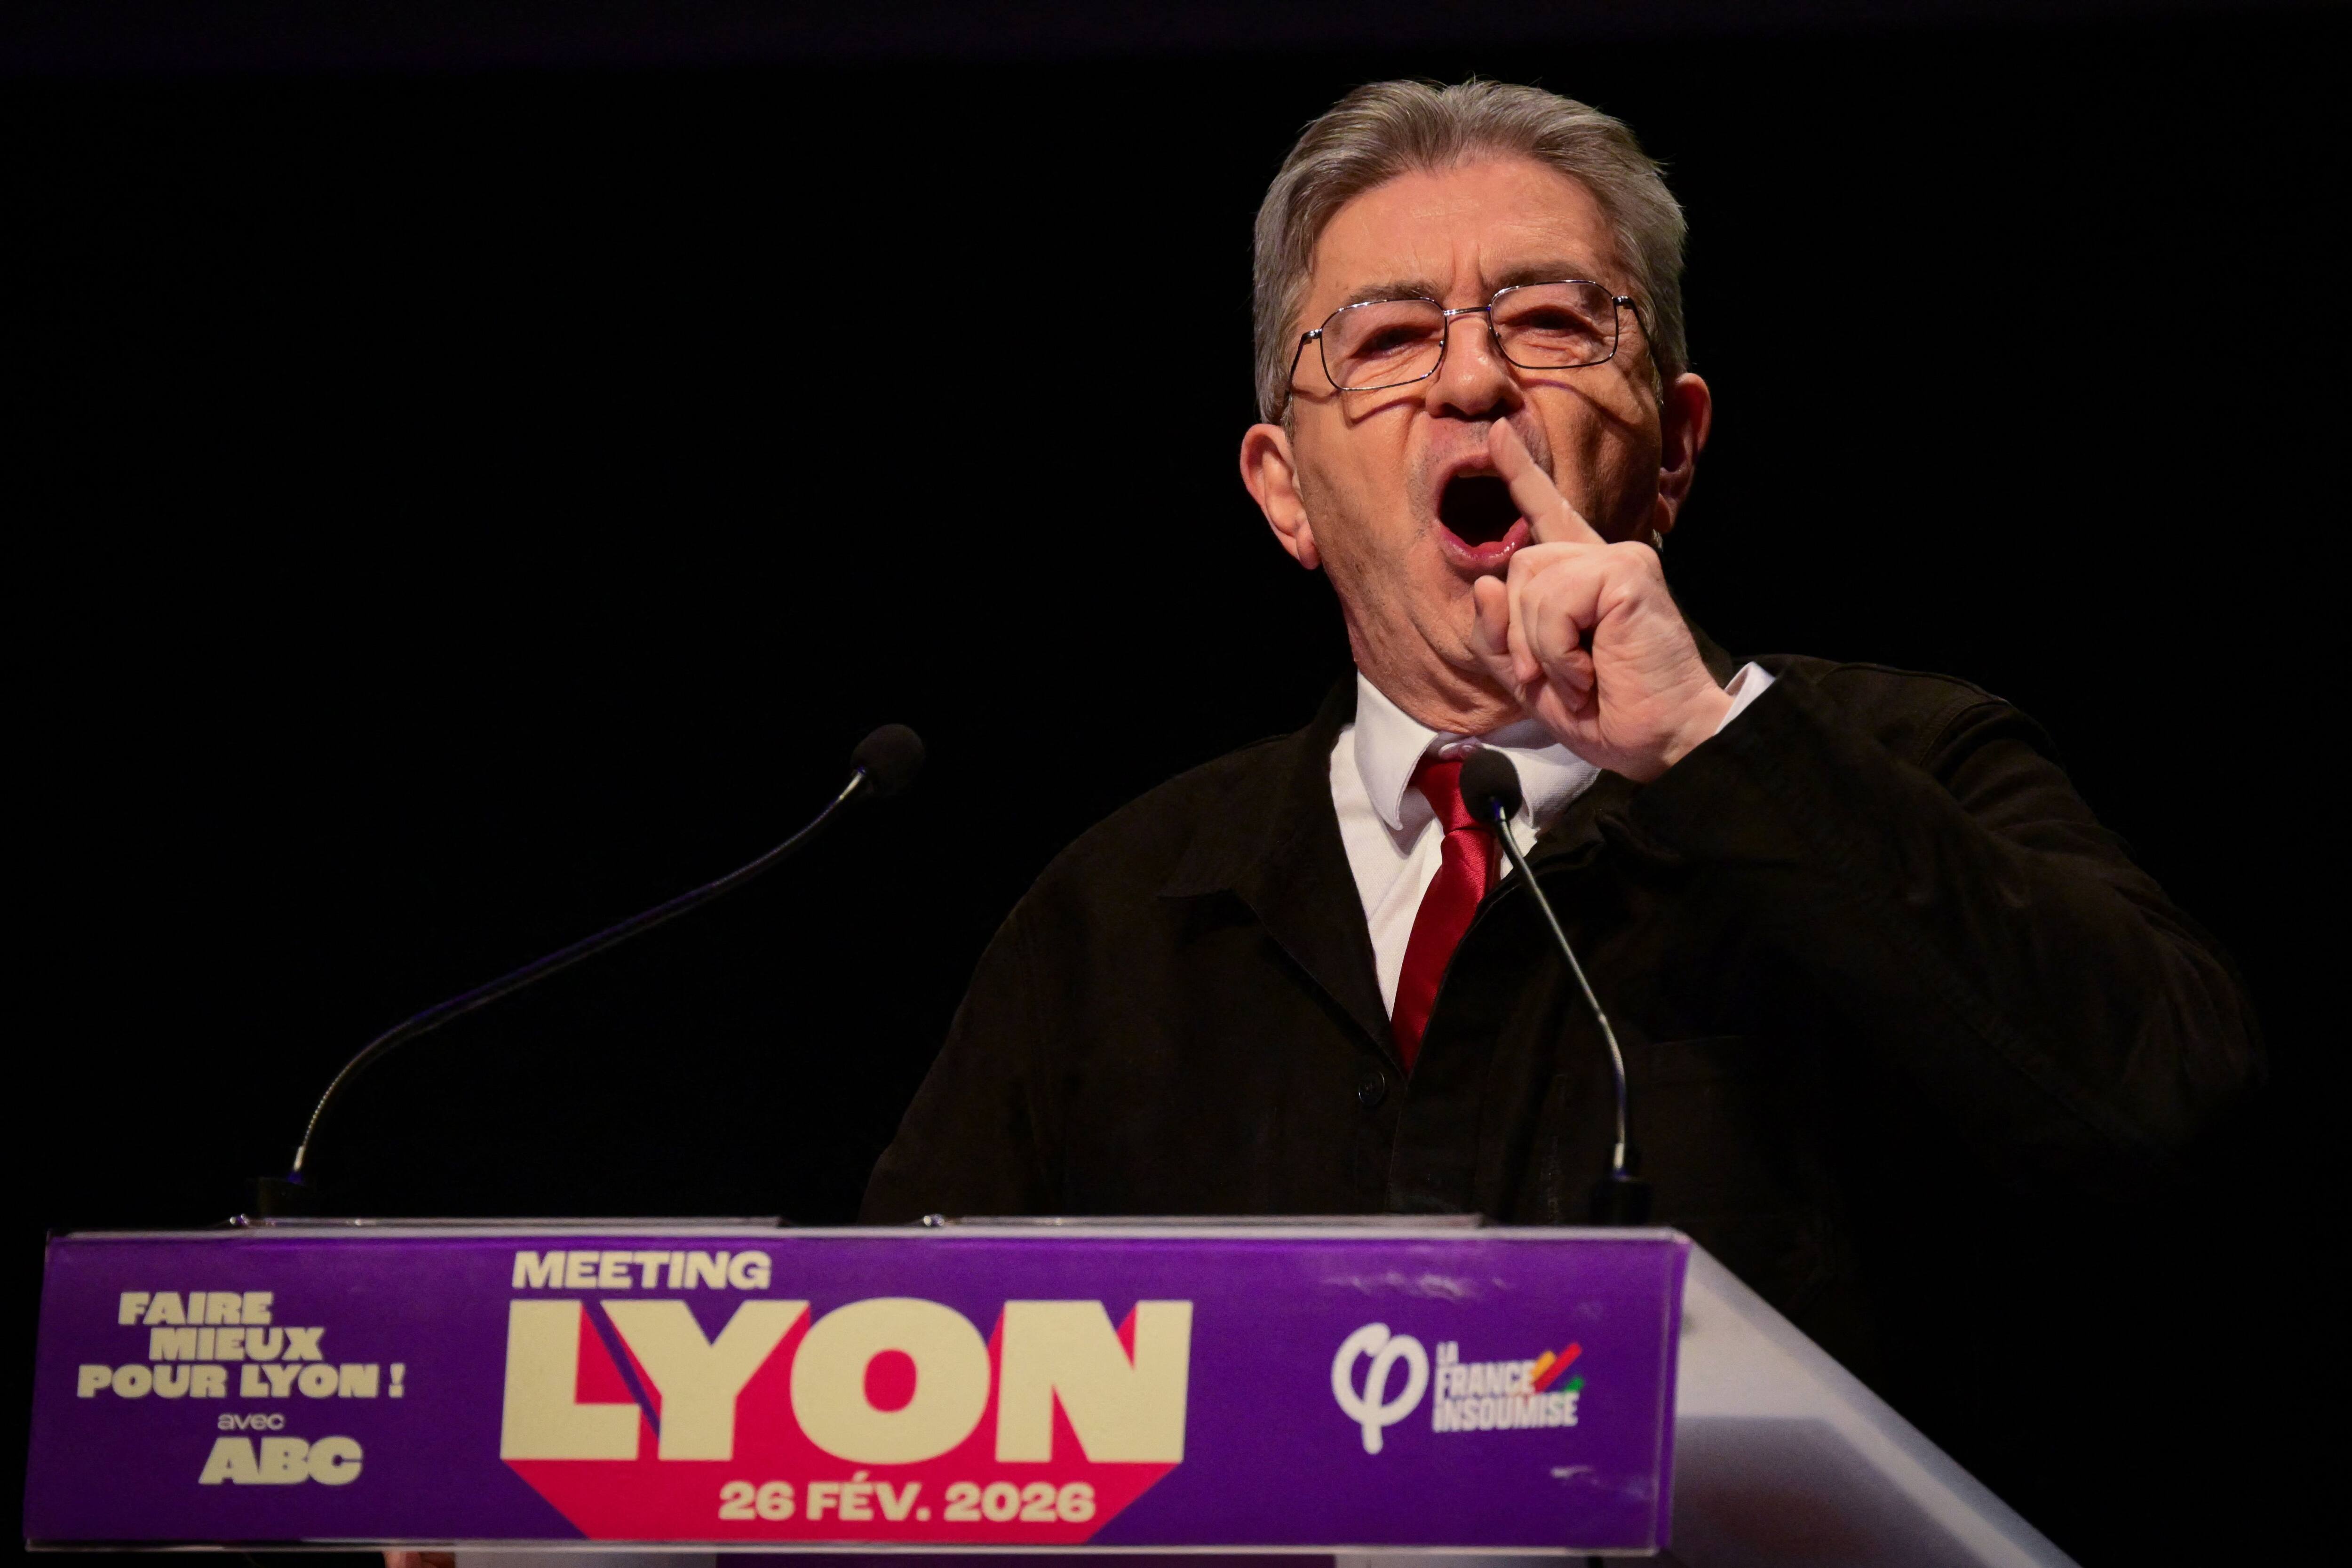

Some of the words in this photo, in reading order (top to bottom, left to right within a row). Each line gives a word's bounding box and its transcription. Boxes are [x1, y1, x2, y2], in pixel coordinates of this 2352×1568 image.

[512, 1250, 772, 1290] MEETING
[118, 1291, 273, 1325] FAIRE
[149, 1327, 325, 1361] MIEUX
[1436, 1341, 1459, 1363] LA
[77, 1364, 227, 1398] POUR
[240, 1363, 380, 1398] LYON
[500, 1297, 1194, 1465] LYON
[1435, 1359, 1537, 1399] FRANCE
[218, 1414, 284, 1430] avec
[199, 1436, 363, 1485] ABC
[719, 1481, 795, 1520] 26
[806, 1471, 930, 1521] FÉV.
[944, 1482, 1096, 1522] 2026
